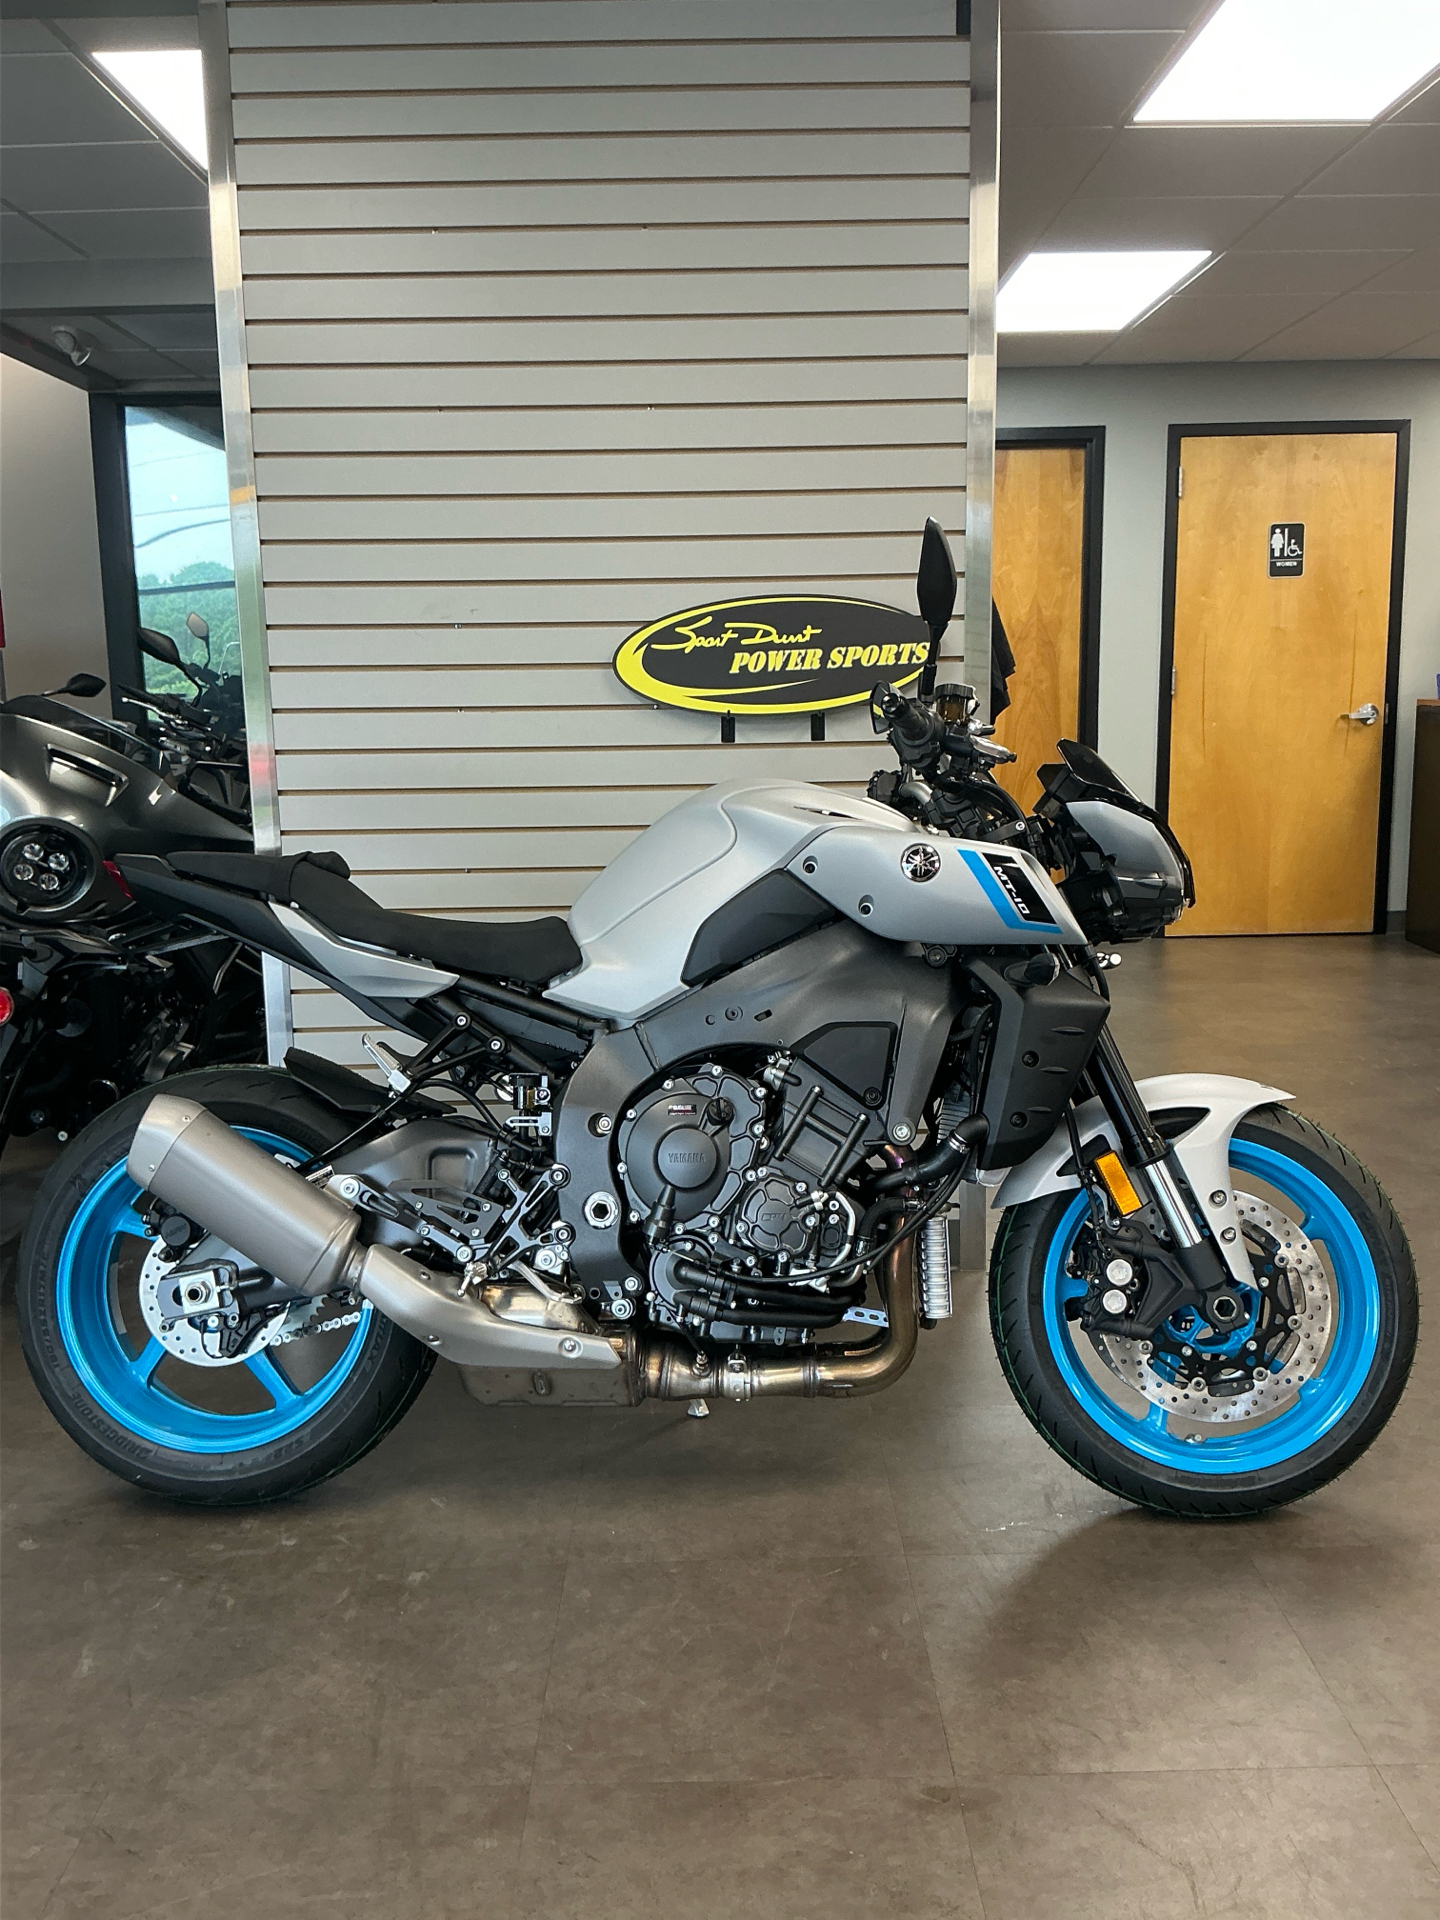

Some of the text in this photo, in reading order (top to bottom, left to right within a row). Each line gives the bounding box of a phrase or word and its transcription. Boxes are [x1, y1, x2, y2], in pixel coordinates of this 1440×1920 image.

[729, 641, 931, 674] POWER SPORTS
[993, 866, 1030, 914] MT-10
[668, 1152, 706, 1164] YAMAHA
[70, 1391, 154, 1460] BRIDGESTONE
